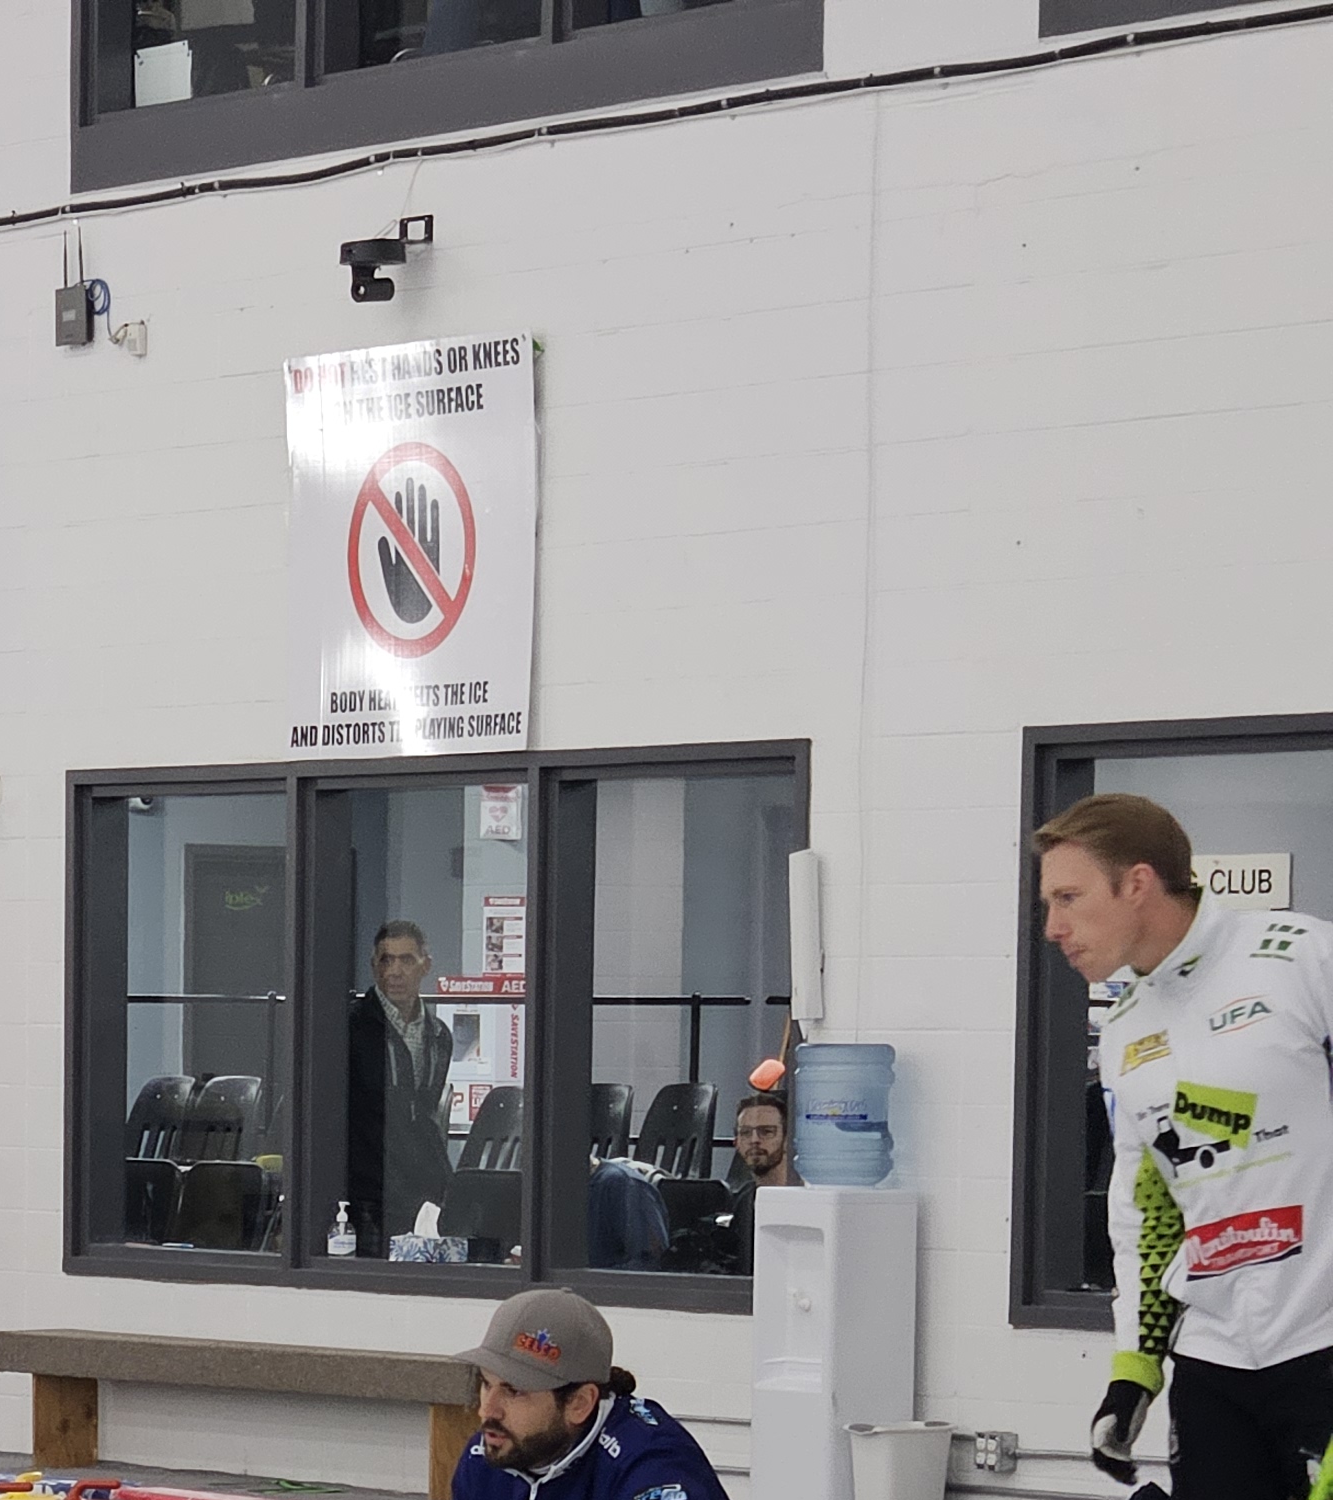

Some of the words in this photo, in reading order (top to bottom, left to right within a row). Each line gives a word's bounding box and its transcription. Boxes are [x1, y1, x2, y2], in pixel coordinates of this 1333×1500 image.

[391, 348, 443, 381] HANDS
[447, 346, 469, 375] OR
[471, 337, 521, 371] KNEES
[415, 382, 484, 418] SURFACE
[330, 690, 367, 714] BODY
[403, 684, 440, 708] ELTS
[443, 682, 466, 706] THE
[468, 681, 489, 705] ICE
[290, 726, 318, 748] AND
[321, 721, 385, 746] DISTORTS
[414, 716, 464, 741] PLAYING
[467, 711, 522, 738] SURFACE
[485, 825, 511, 835] AED
[1209, 868, 1273, 895] CLUB
[1208, 1001, 1273, 1032] UFA
[1173, 1091, 1252, 1135] Dump
